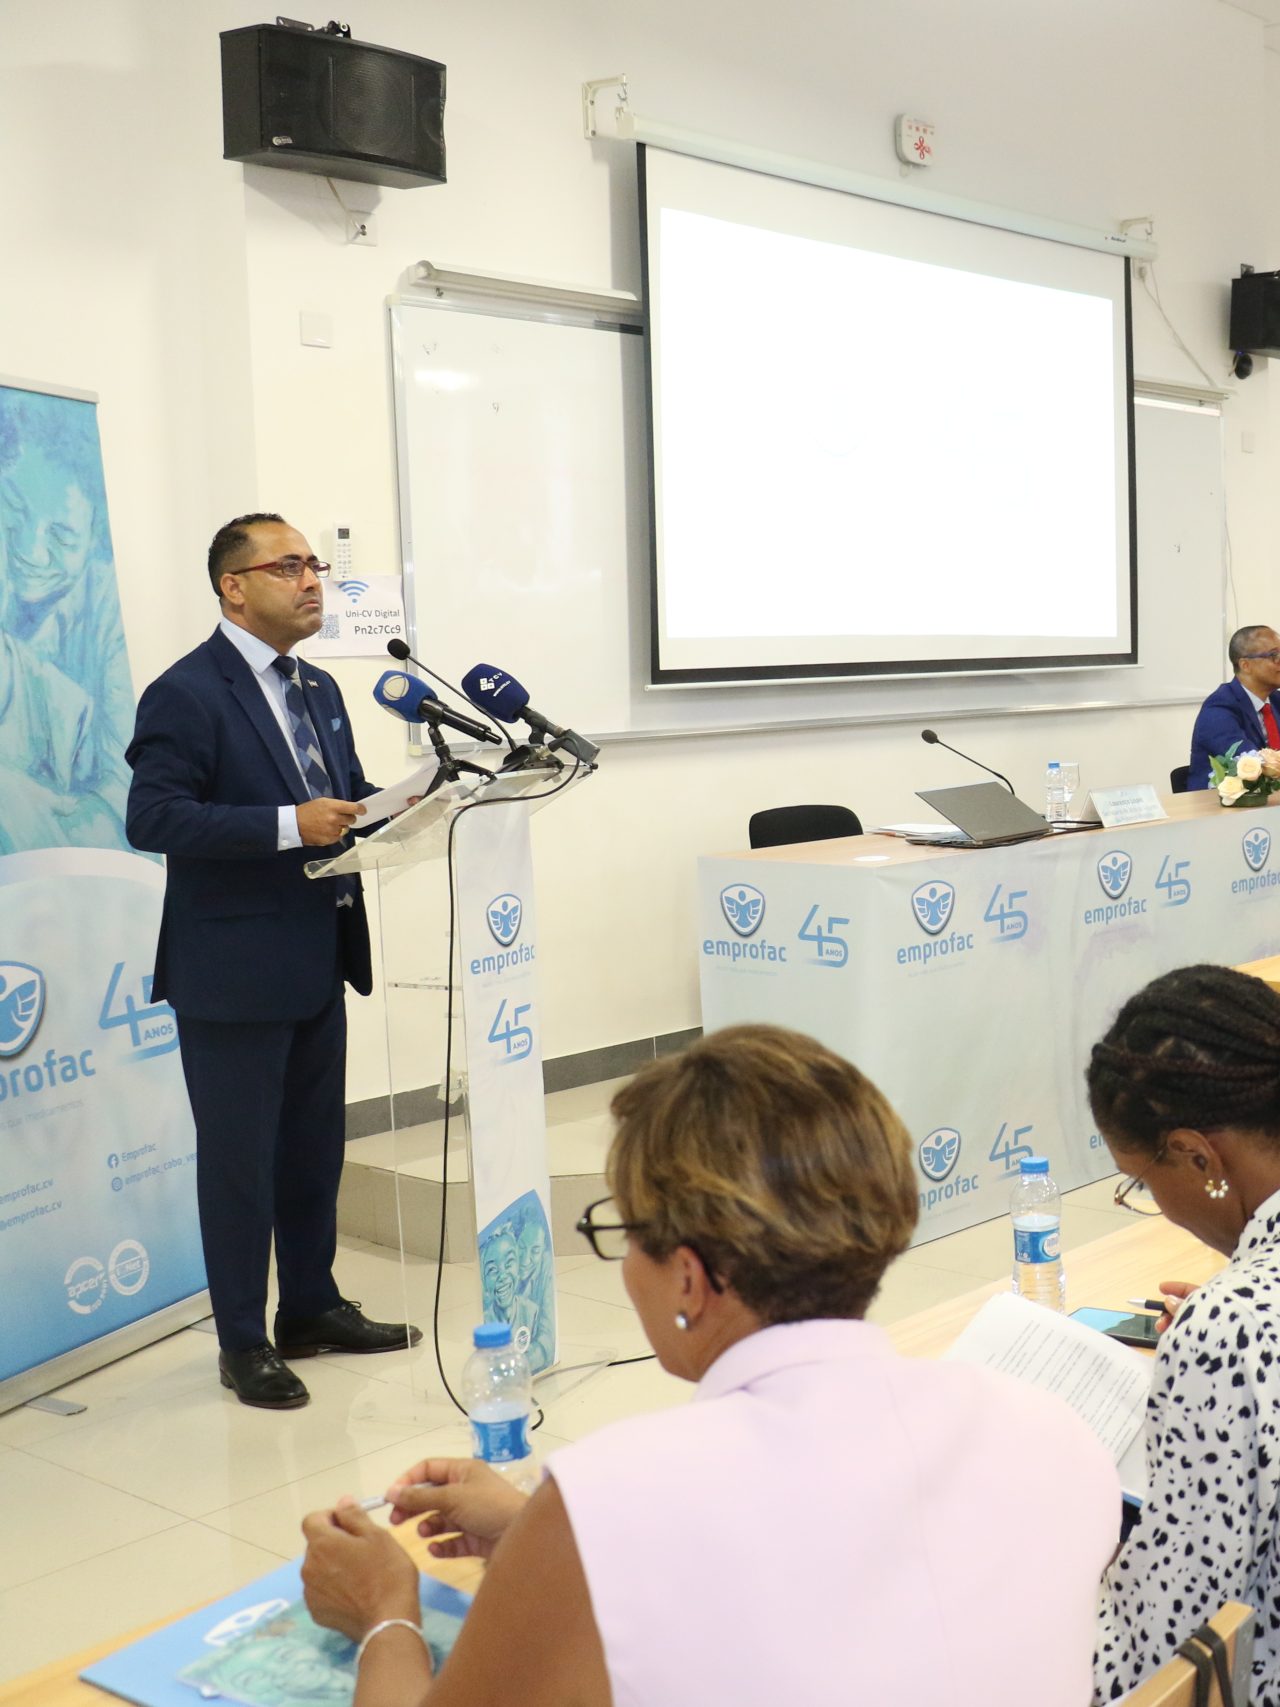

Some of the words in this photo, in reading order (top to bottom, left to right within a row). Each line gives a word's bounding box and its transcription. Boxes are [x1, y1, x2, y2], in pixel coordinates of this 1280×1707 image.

[346, 610, 372, 618] Uni-CV
[375, 609, 400, 618] Digital
[354, 625, 401, 635] Pn2c7Cc9
[1155, 854, 1191, 908] 45
[983, 883, 1029, 944] 45
[1084, 896, 1147, 925] emprofac
[797, 904, 850, 968] 45
[1006, 921, 1022, 931] ANOS
[470, 944, 535, 975] emprofac
[703, 938, 787, 962] emprofac
[825, 948, 843, 957] ANOS
[896, 931, 974, 964] emprofac
[144, 1023, 174, 1041] ANOS
[487, 998, 533, 1064] 45
[513, 1038, 528, 1050] ANOS
[122, 1143, 156, 1162] Emprofac
[125, 1151, 198, 1186] emprofac_cabo_ve
